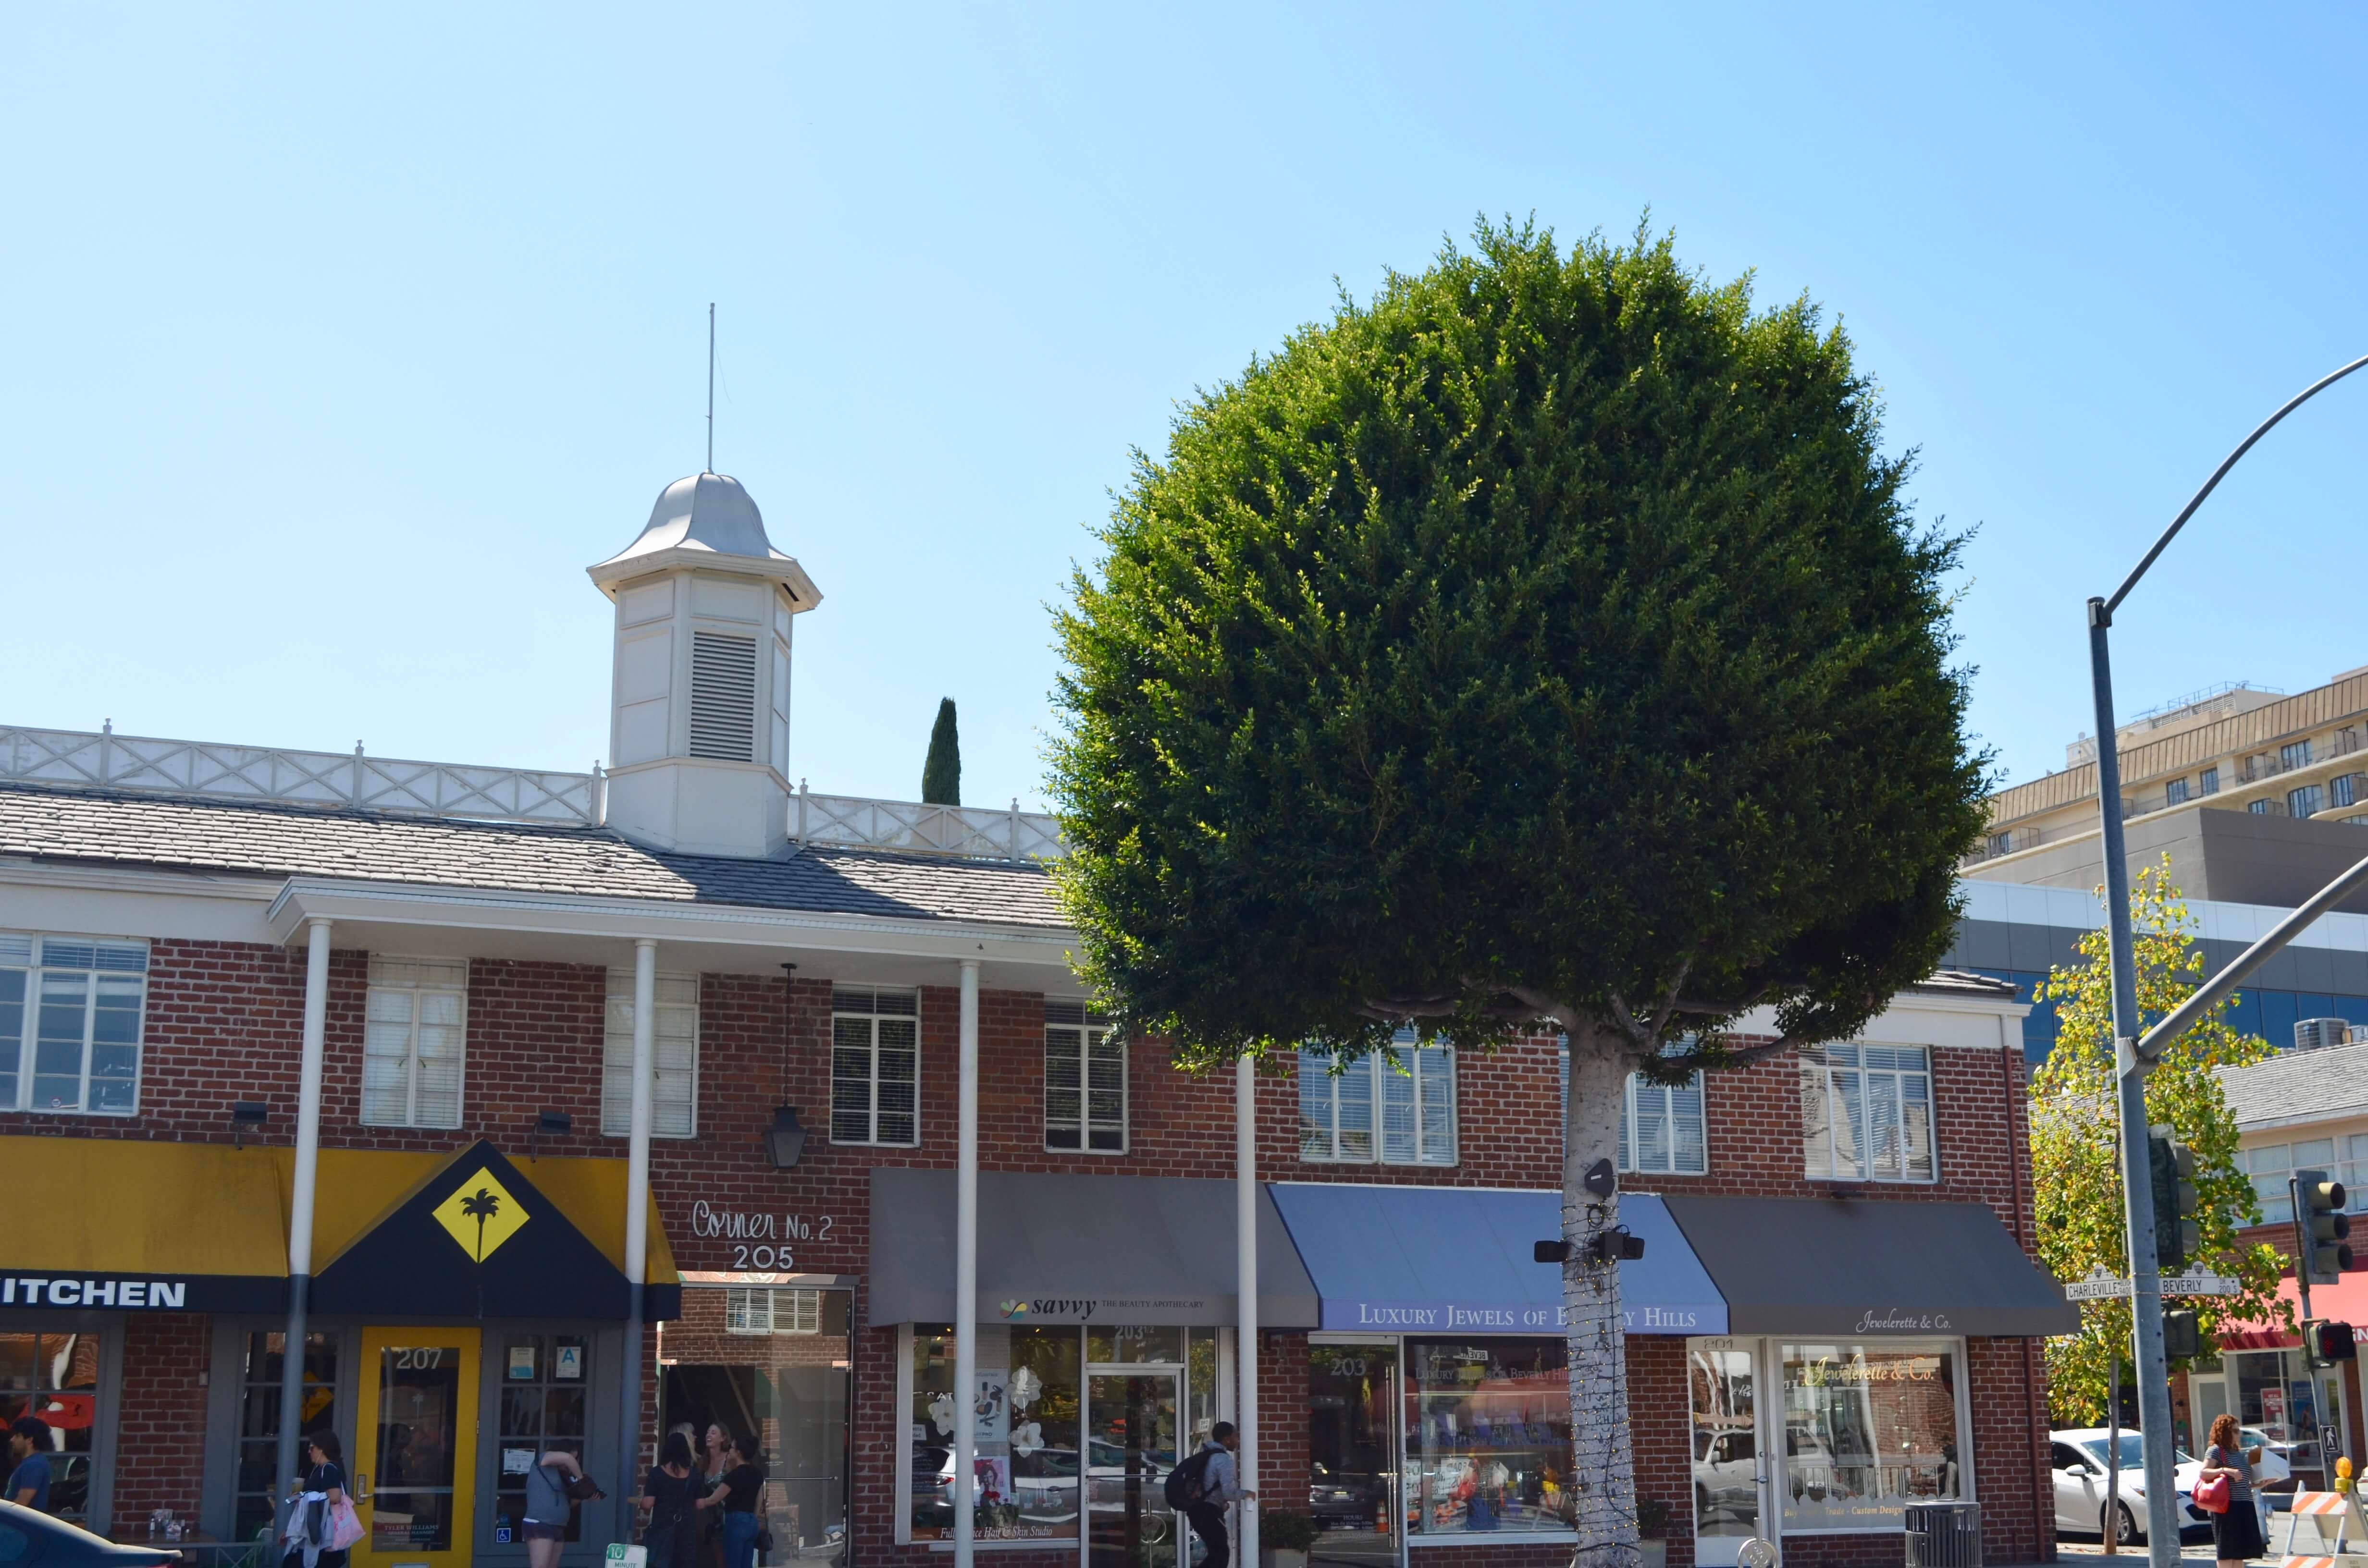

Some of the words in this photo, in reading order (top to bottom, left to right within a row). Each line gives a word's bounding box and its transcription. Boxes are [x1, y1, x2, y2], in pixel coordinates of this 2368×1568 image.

[693, 1200, 777, 1239] Corner
[786, 1214, 814, 1240] No.
[819, 1215, 832, 1240] 2
[733, 1245, 793, 1269] 205
[0, 1278, 185, 1307] ITCHEN
[2069, 1282, 2118, 1298] CHARLEVILLE
[2163, 1279, 2202, 1292] BEVERLY
[2219, 1285, 2230, 1293] 200
[1032, 1298, 1097, 1320] savvy
[1359, 1304, 1438, 1324] LUXURY
[1446, 1305, 1514, 1329] JEWELS
[1523, 1310, 1547, 1326] OF
[1644, 1307, 1696, 1327] HILLS
[1855, 1308, 1917, 1333] Jewelerette
[1920, 1314, 1931, 1329] &
[1934, 1314, 1951, 1329] Co.
[1704, 1339, 1733, 1349] 201
[396, 1348, 443, 1370] 207
[561, 1347, 576, 1363] A
[1330, 1357, 1366, 1376] 203
[1510, 1368, 1551, 1380] BEVERLY
[1553, 1368, 1569, 1380] HIL
[1805, 1354, 1887, 1386] Jewelerette
[1891, 1360, 1905, 1380] &
[1909, 1357, 1934, 1381] Co.
[1851, 1506, 1877, 1514] Custom
[1879, 1506, 1903, 1517] Design
[984, 1526, 1000, 1538] Hair
[1012, 1526, 1028, 1537] Skin
[1030, 1525, 1053, 1537] Studio
[611, 1546, 623, 1559] 10
